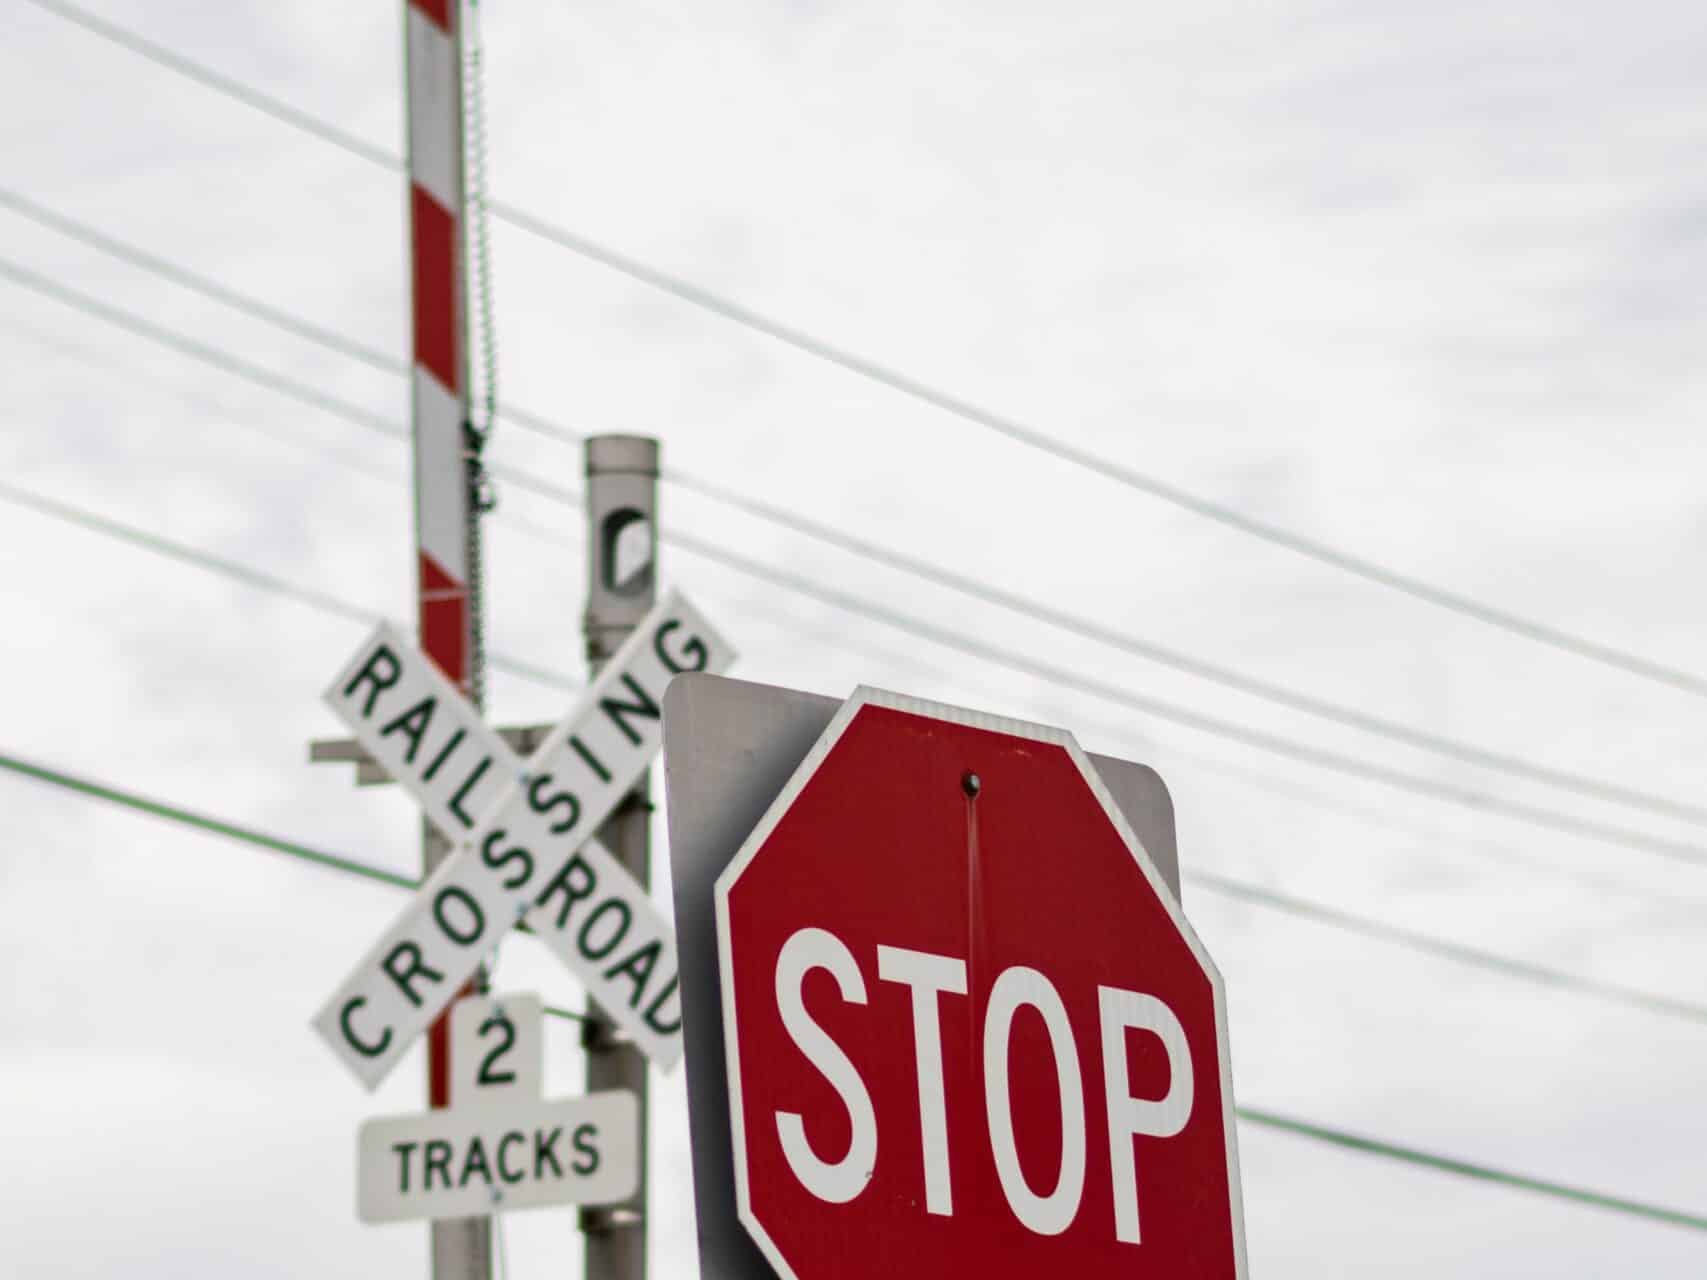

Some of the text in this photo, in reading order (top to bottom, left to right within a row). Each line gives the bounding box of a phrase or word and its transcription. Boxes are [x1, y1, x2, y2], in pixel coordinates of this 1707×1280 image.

[339, 619, 709, 1058] CROSSING
[475, 1016, 516, 1086] 2
[774, 926, 1195, 1246] STOP
[391, 1123, 601, 1193] TRACKS
